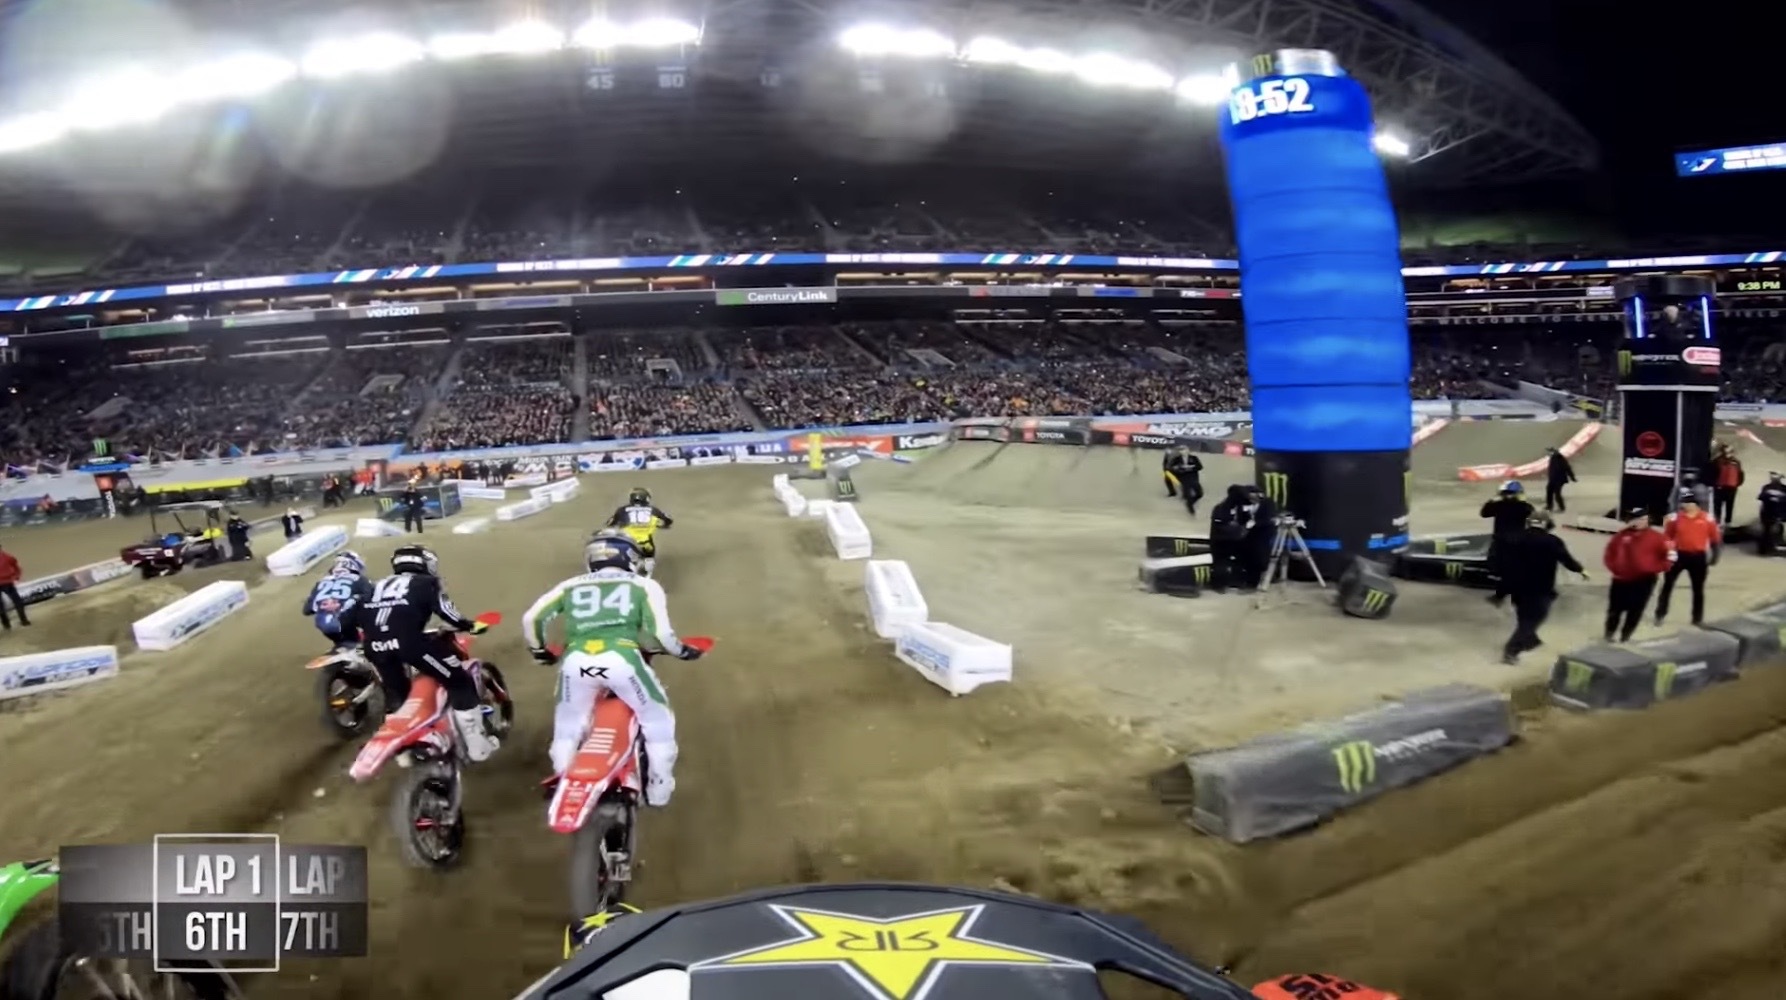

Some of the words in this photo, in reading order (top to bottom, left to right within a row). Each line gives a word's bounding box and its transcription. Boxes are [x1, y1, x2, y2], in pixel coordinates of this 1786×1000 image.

[747, 290, 828, 303] CenturyLink
[1737, 282, 1761, 291] 9:38
[1762, 281, 1780, 290] PM
[366, 305, 420, 318] verizon
[314, 580, 353, 601] 25
[371, 575, 413, 602] 14
[571, 583, 634, 619] 94
[629, 675, 648, 706] HONDA
